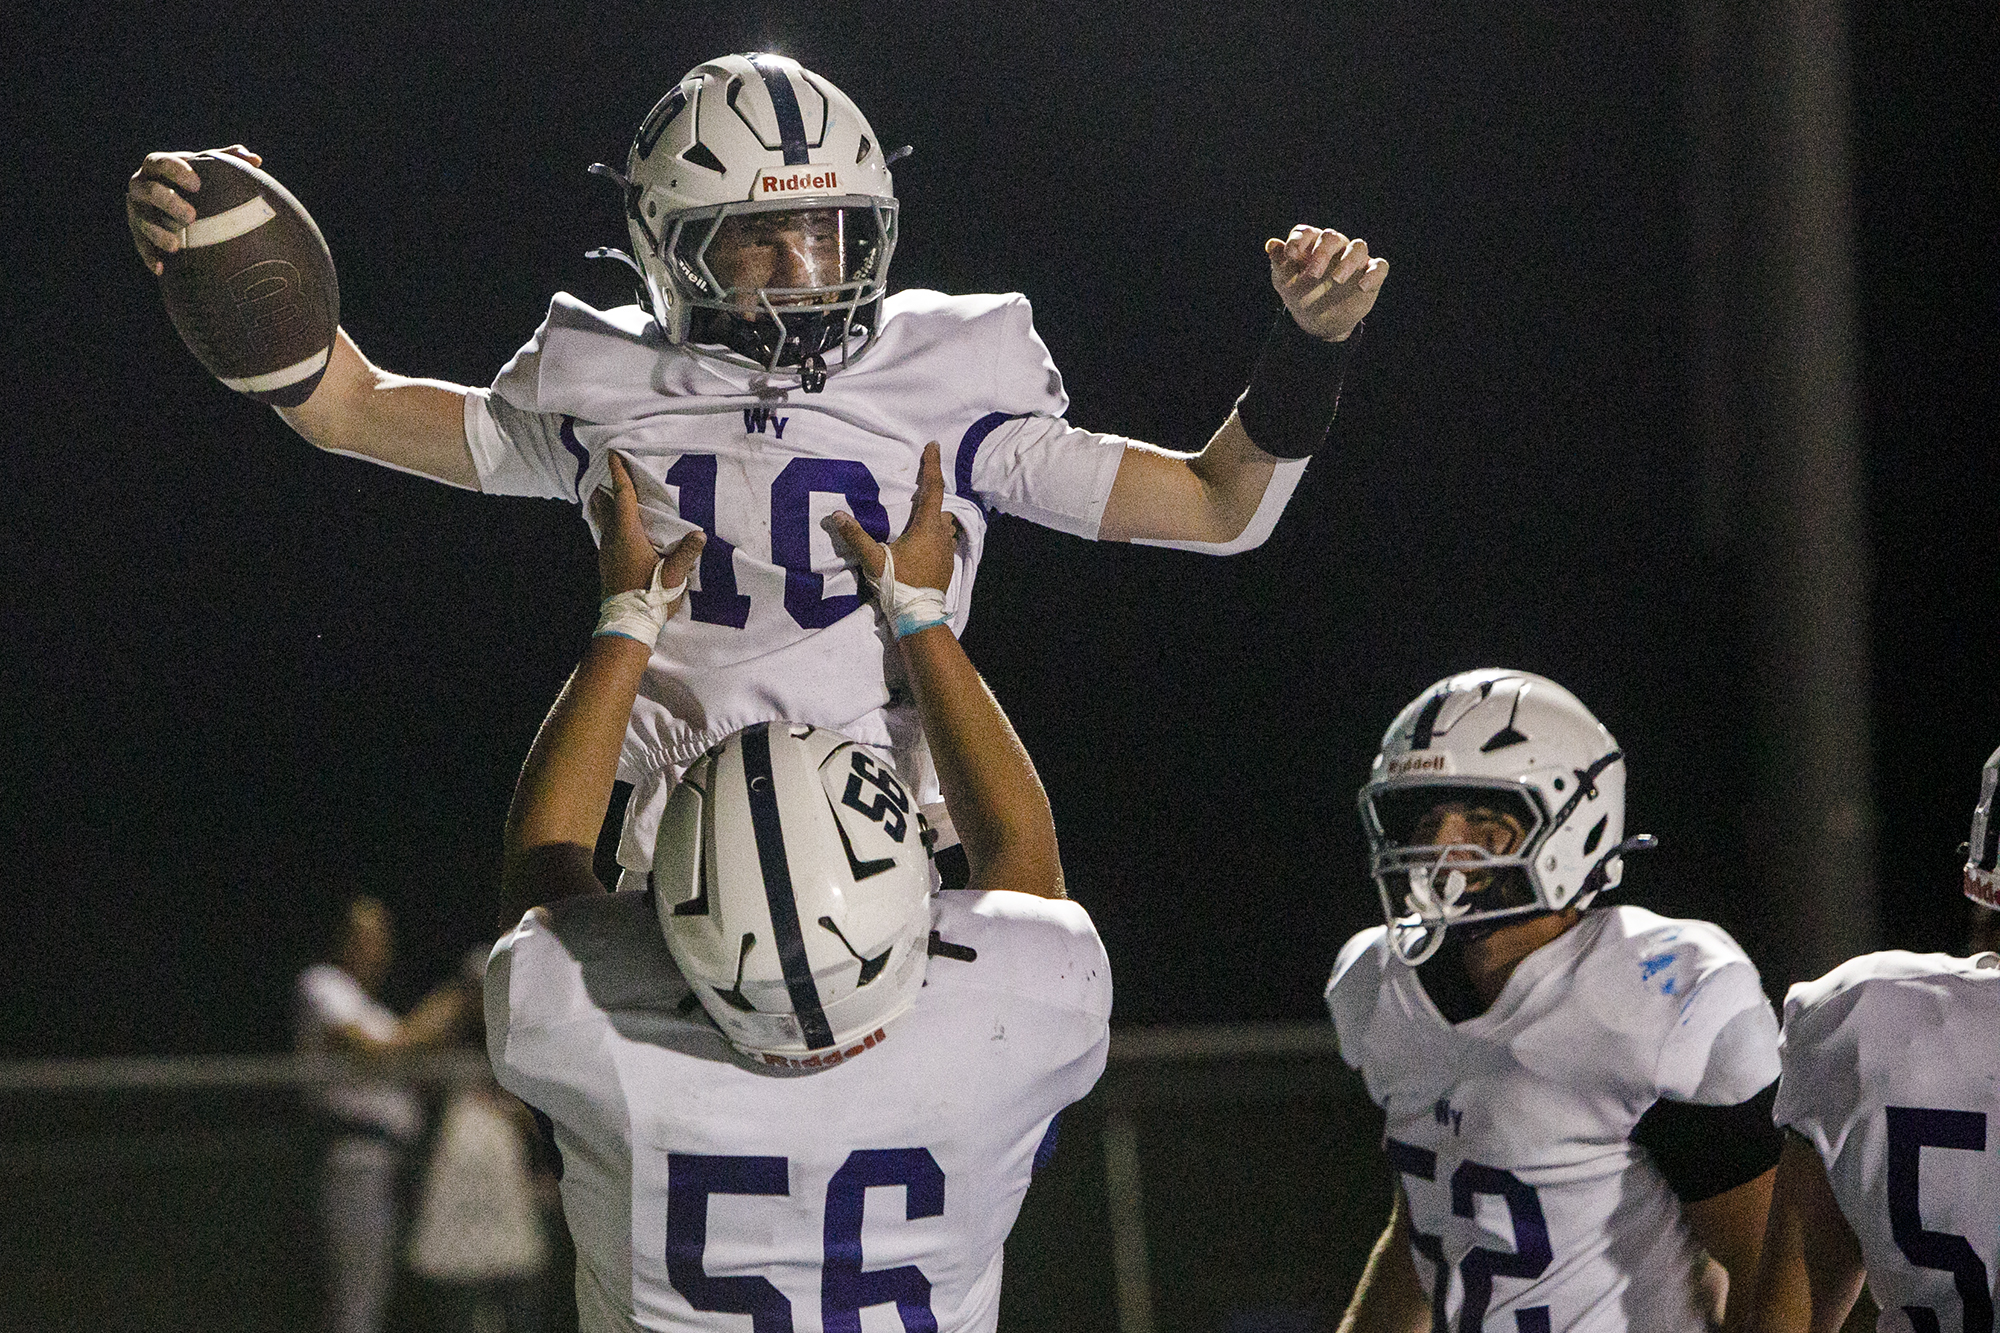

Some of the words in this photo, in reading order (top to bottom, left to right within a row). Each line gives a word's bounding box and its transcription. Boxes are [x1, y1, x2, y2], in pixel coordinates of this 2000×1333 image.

[762, 171, 837, 192] Riddell
[744, 408, 789, 439] WY
[666, 454, 890, 629] 10
[841, 751, 909, 843] 56
[666, 1147, 945, 1333] 56
